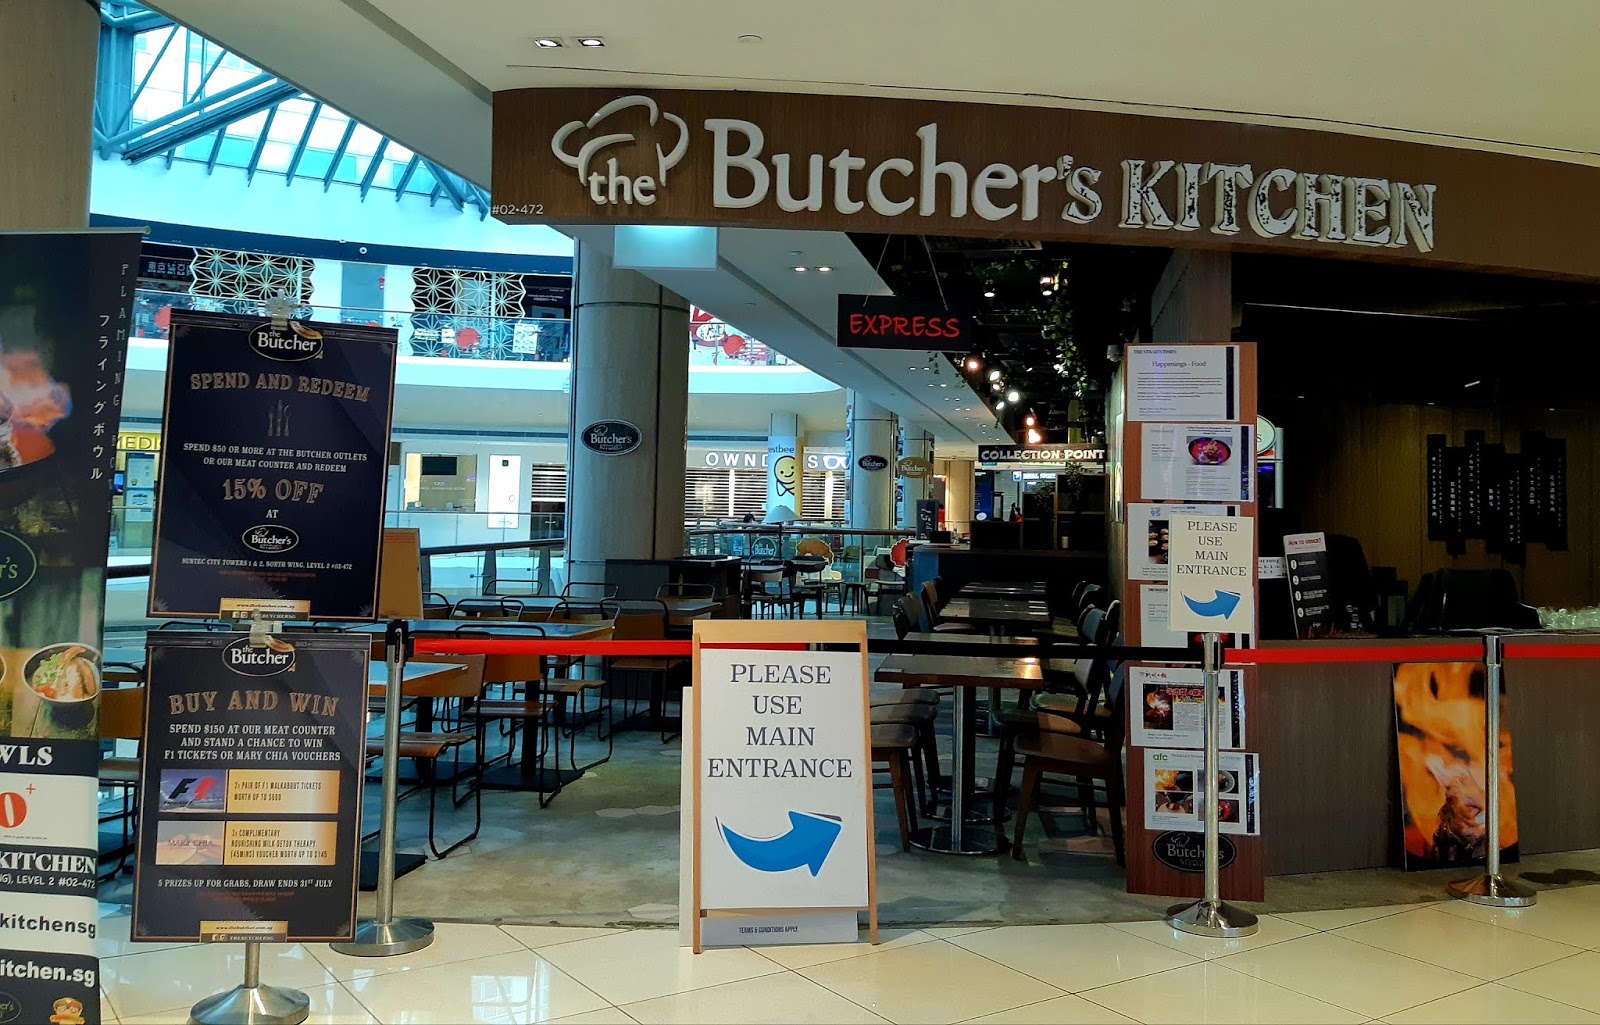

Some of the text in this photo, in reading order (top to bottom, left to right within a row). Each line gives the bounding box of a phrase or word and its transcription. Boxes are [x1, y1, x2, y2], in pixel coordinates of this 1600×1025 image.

[588, 157, 658, 206] the
[704, 118, 1438, 253] Butcher's KITCHEN
[492, 204, 544, 215] #02-472
[850, 313, 960, 338] EXPRESS
[257, 332, 317, 351] Butcher
[190, 372, 371, 403] SPEND AND REDEEM
[90, 315, 110, 480] フライングボウル
[183, 443, 210, 452] SPEND
[228, 446, 240, 454] OR
[241, 446, 264, 455] MORE
[266, 448, 276, 456] AT
[278, 448, 294, 457] THE
[296, 449, 332, 459] BUTCHER
[333, 452, 368, 461] OUTLETS
[980, 449, 1106, 460] COLLECTION POINT
[203, 457, 347, 473] OR OUR MEAT COUNTER AND REDEEM
[222, 477, 324, 504] 15% OFF
[265, 509, 279, 519] AT
[1187, 521, 1238, 532] PLEASE
[251, 535, 292, 545] Butcher's
[1198, 536, 1223, 547] USE
[1195, 550, 1229, 561] MAIN
[1176, 564, 1247, 577] ENTRANCE
[231, 648, 289, 665] Butcher
[242, 645, 253, 653] the
[730, 663, 832, 685] PLEASE
[168, 689, 339, 717] BUY AND WIN
[752, 695, 803, 716] USE
[169, 724, 335, 735] SPEND $150 AT OUR MEAT COUNTER
[746, 726, 816, 747] MAIN
[181, 737, 323, 748] AND STAND A CHANCE TO WIN
[164, 750, 341, 761] F1 TICKETS OR MARY CHIA VOUCHERS
[1152, 752, 1168, 761] afc
[707, 758, 852, 779] ENTRANCE
[16, 875, 45, 885] LEVEL
[48, 876, 55, 886] 2
[58, 877, 96, 889] #02-472
[158, 879, 163, 888] 5
[164, 879, 193, 888] PRIZES
[194, 879, 205, 888] UP
[206, 879, 222, 888] FOR
[253, 879, 276, 888] DRAW
[278, 879, 299, 888] ENDS
[314, 879, 333, 888] JULY
[0, 913, 96, 939] kitchensg
[739, 926, 754, 934] TERMS
